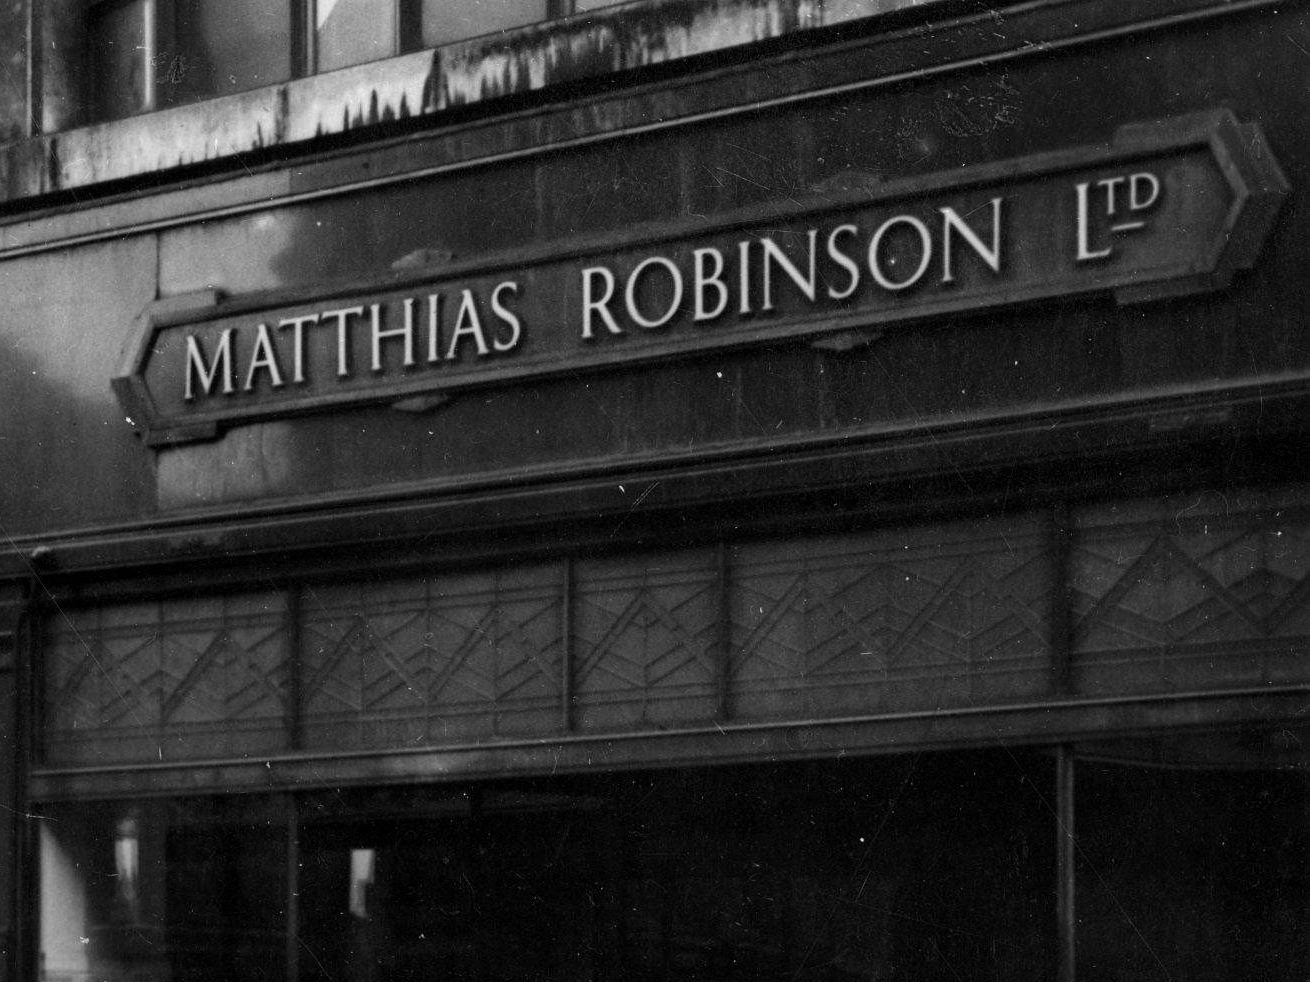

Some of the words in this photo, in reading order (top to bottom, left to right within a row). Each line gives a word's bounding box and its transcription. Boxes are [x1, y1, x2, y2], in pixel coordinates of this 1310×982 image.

[184, 281, 521, 400] MATTHIAS
[580, 198, 1004, 339] ROBINSON
[1075, 171, 1161, 262] LTD
